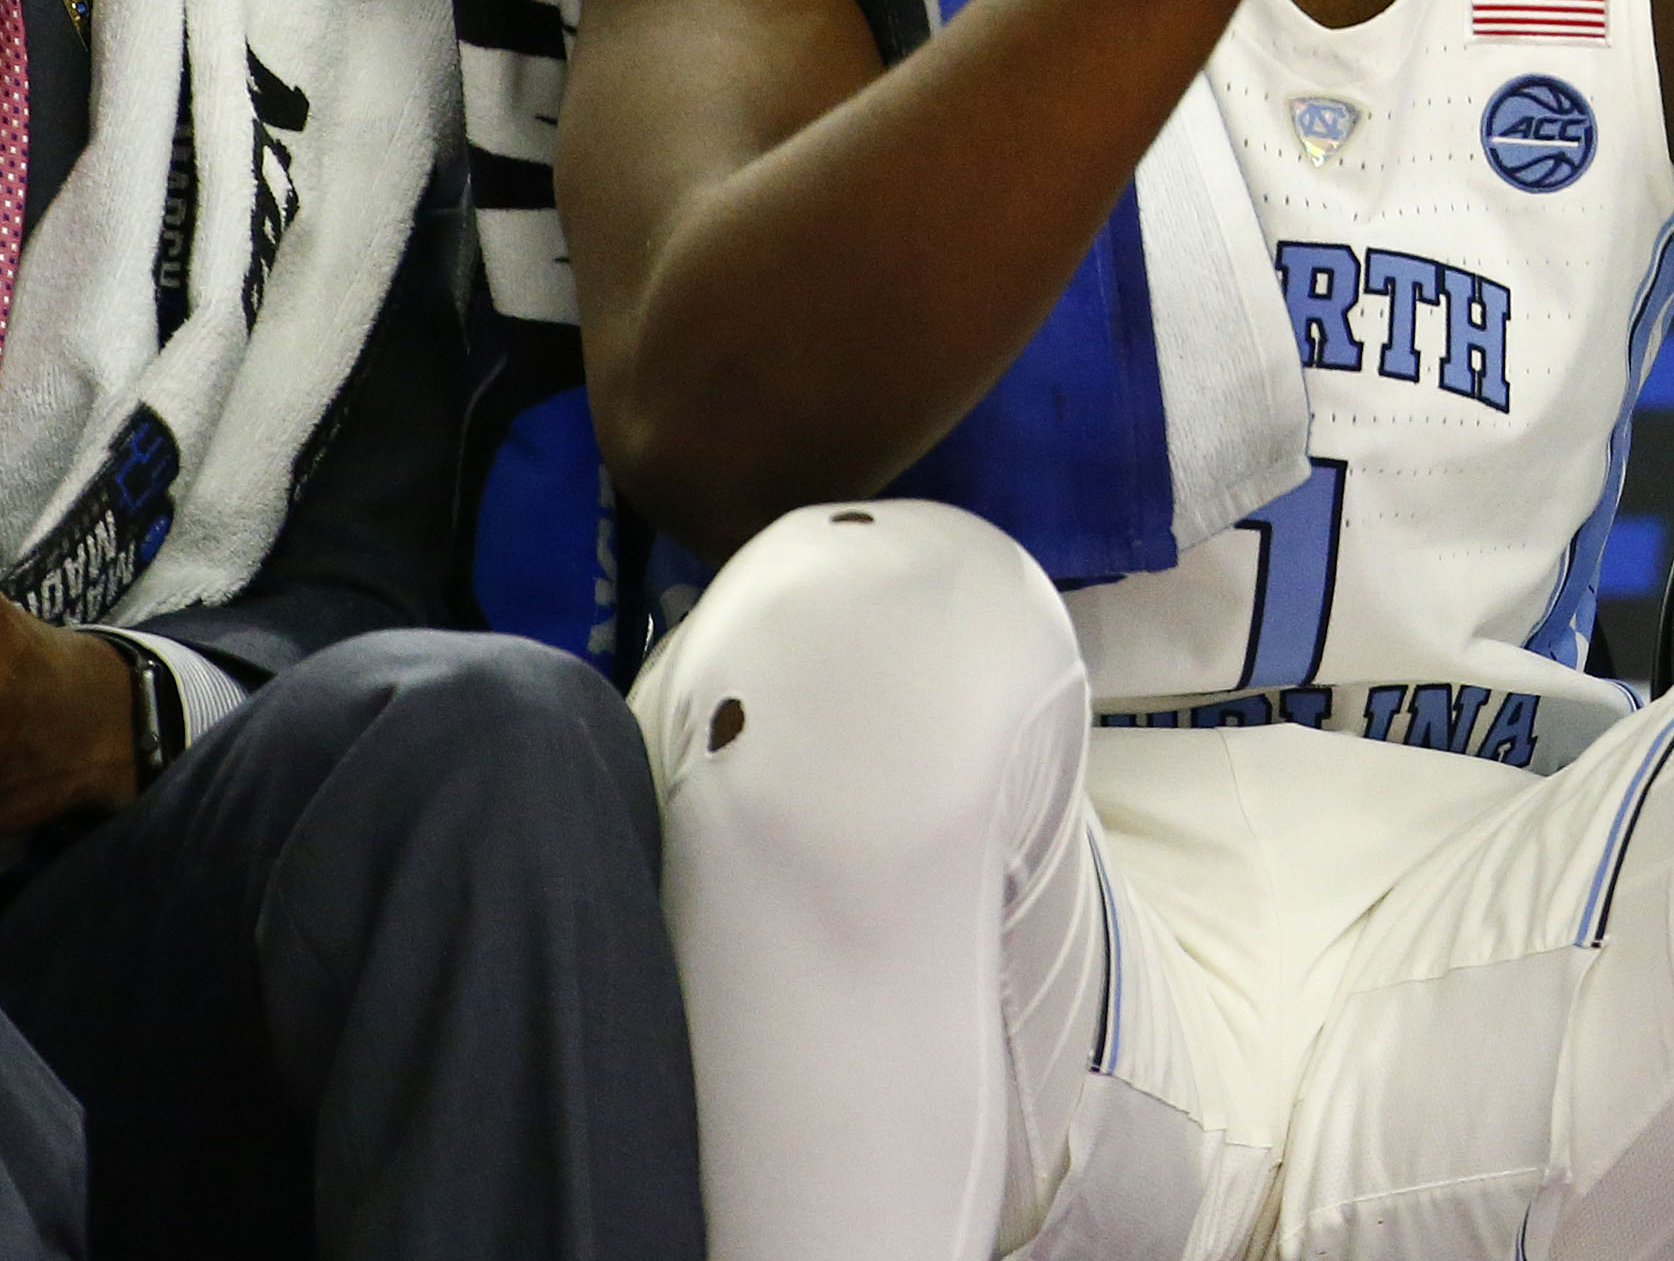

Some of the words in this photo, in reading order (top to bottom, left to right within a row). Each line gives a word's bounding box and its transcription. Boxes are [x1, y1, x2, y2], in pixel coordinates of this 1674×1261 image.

[1498, 116, 1588, 141] ACC
[1275, 240, 1511, 413] RTH
[1235, 458, 1347, 690] 1
